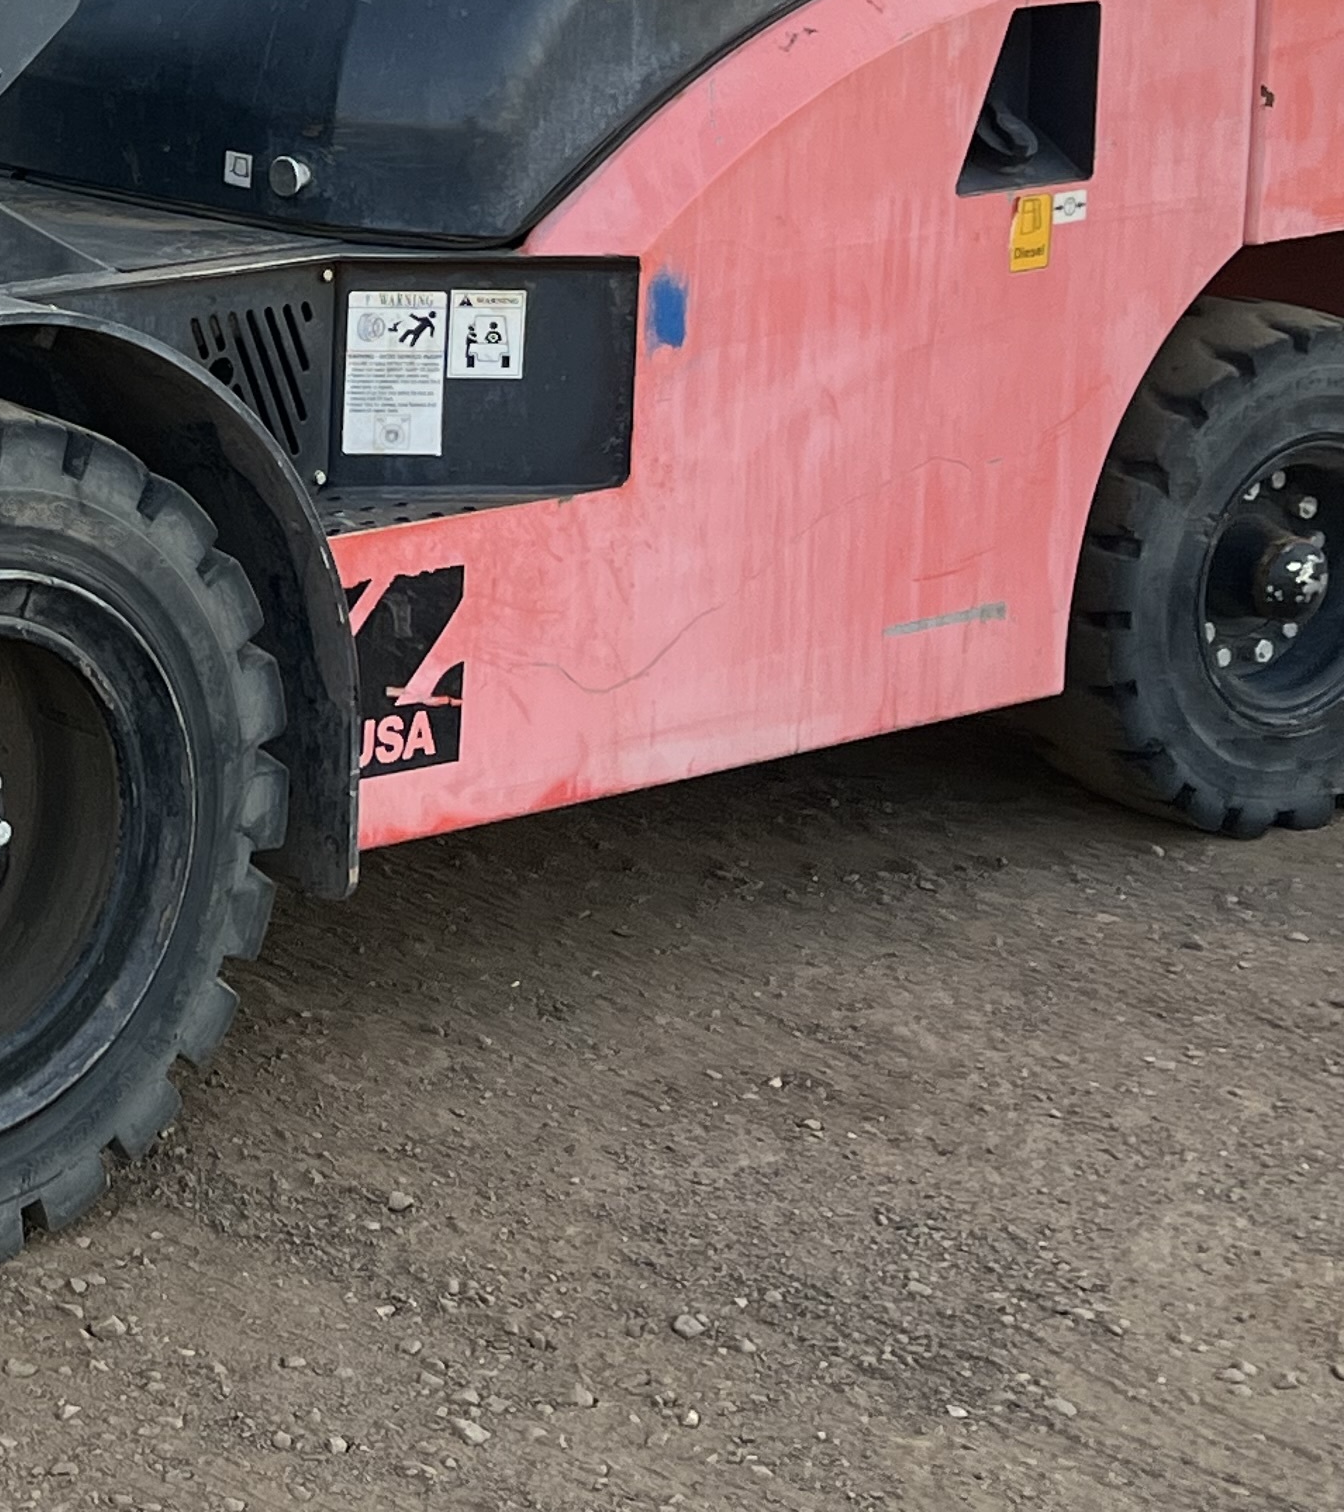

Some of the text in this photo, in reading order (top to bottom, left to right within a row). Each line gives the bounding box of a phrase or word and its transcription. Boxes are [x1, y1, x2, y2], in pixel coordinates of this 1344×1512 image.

[1014, 244, 1046, 259] Diesel
[379, 292, 434, 307] WARNING
[476, 296, 520, 305] WARNING
